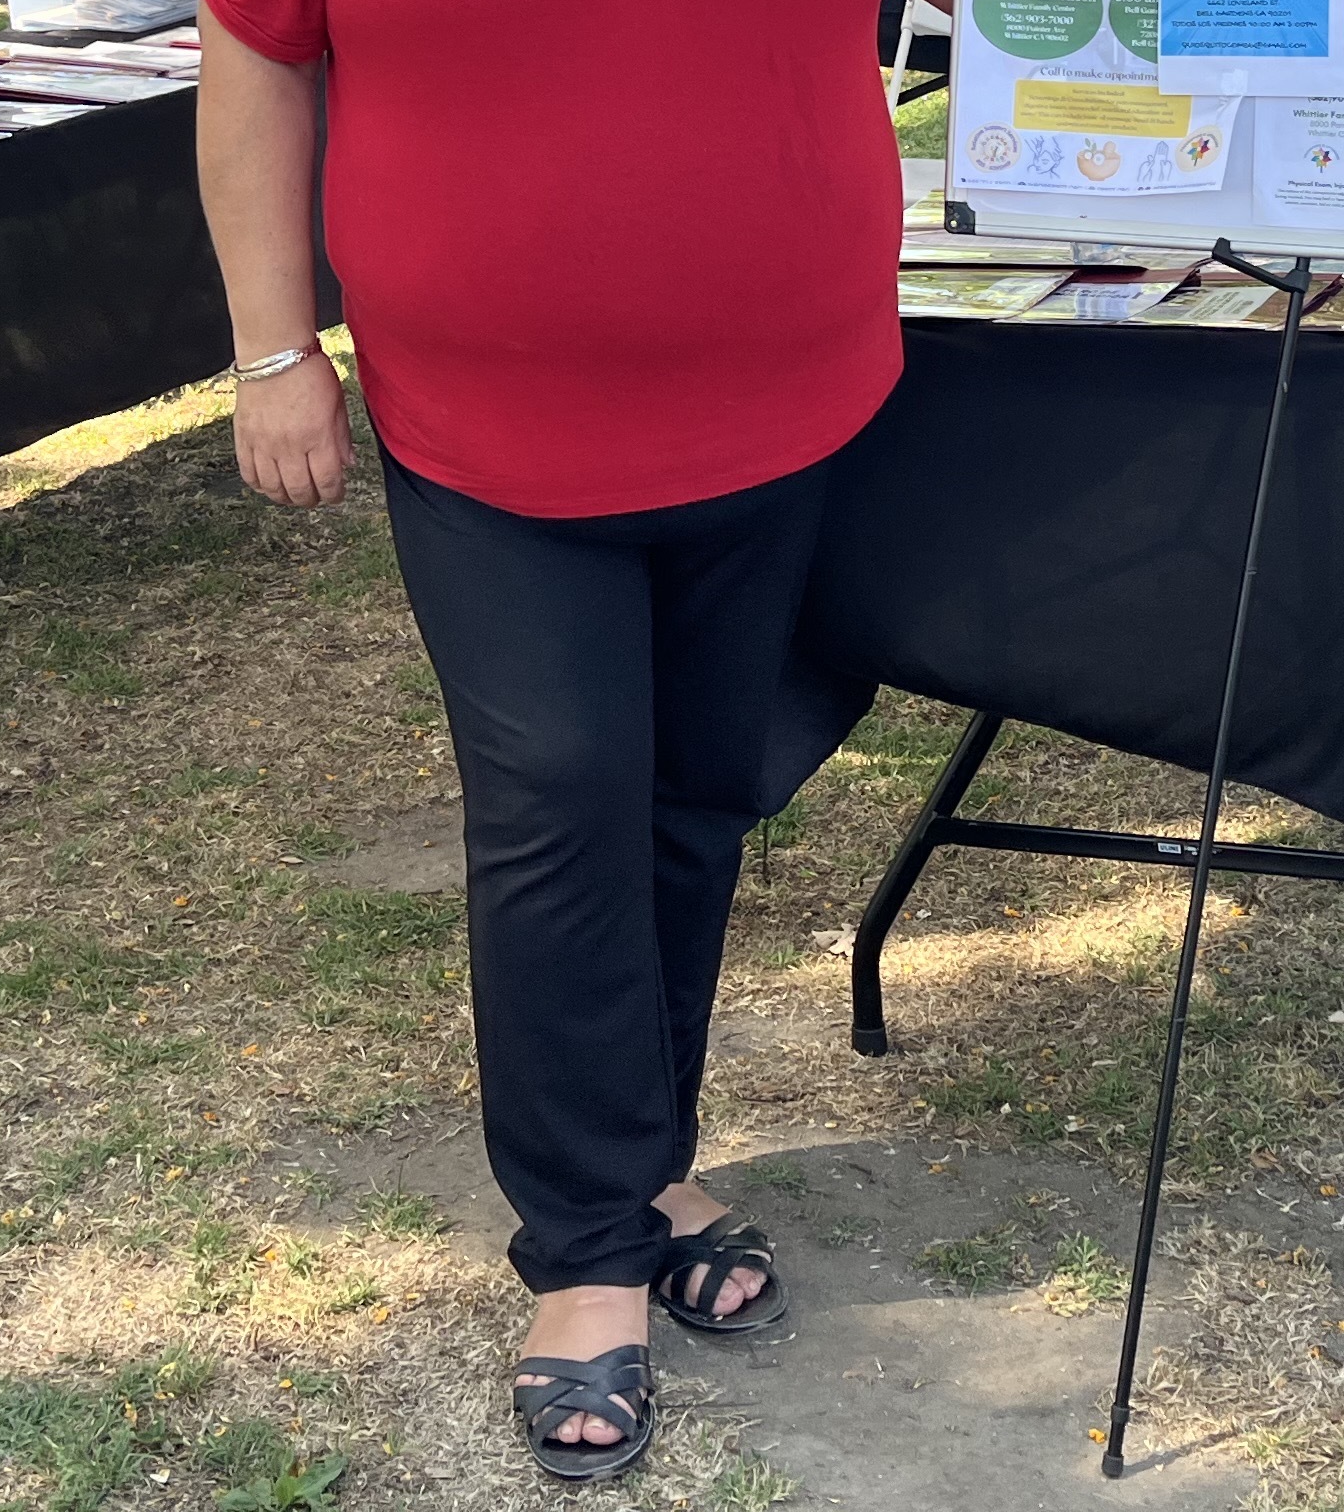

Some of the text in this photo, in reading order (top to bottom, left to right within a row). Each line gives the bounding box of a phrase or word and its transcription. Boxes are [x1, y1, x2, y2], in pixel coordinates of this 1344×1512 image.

[1041, 66, 1103, 79] Call make
[1293, 110, 1328, 119] Whittier
